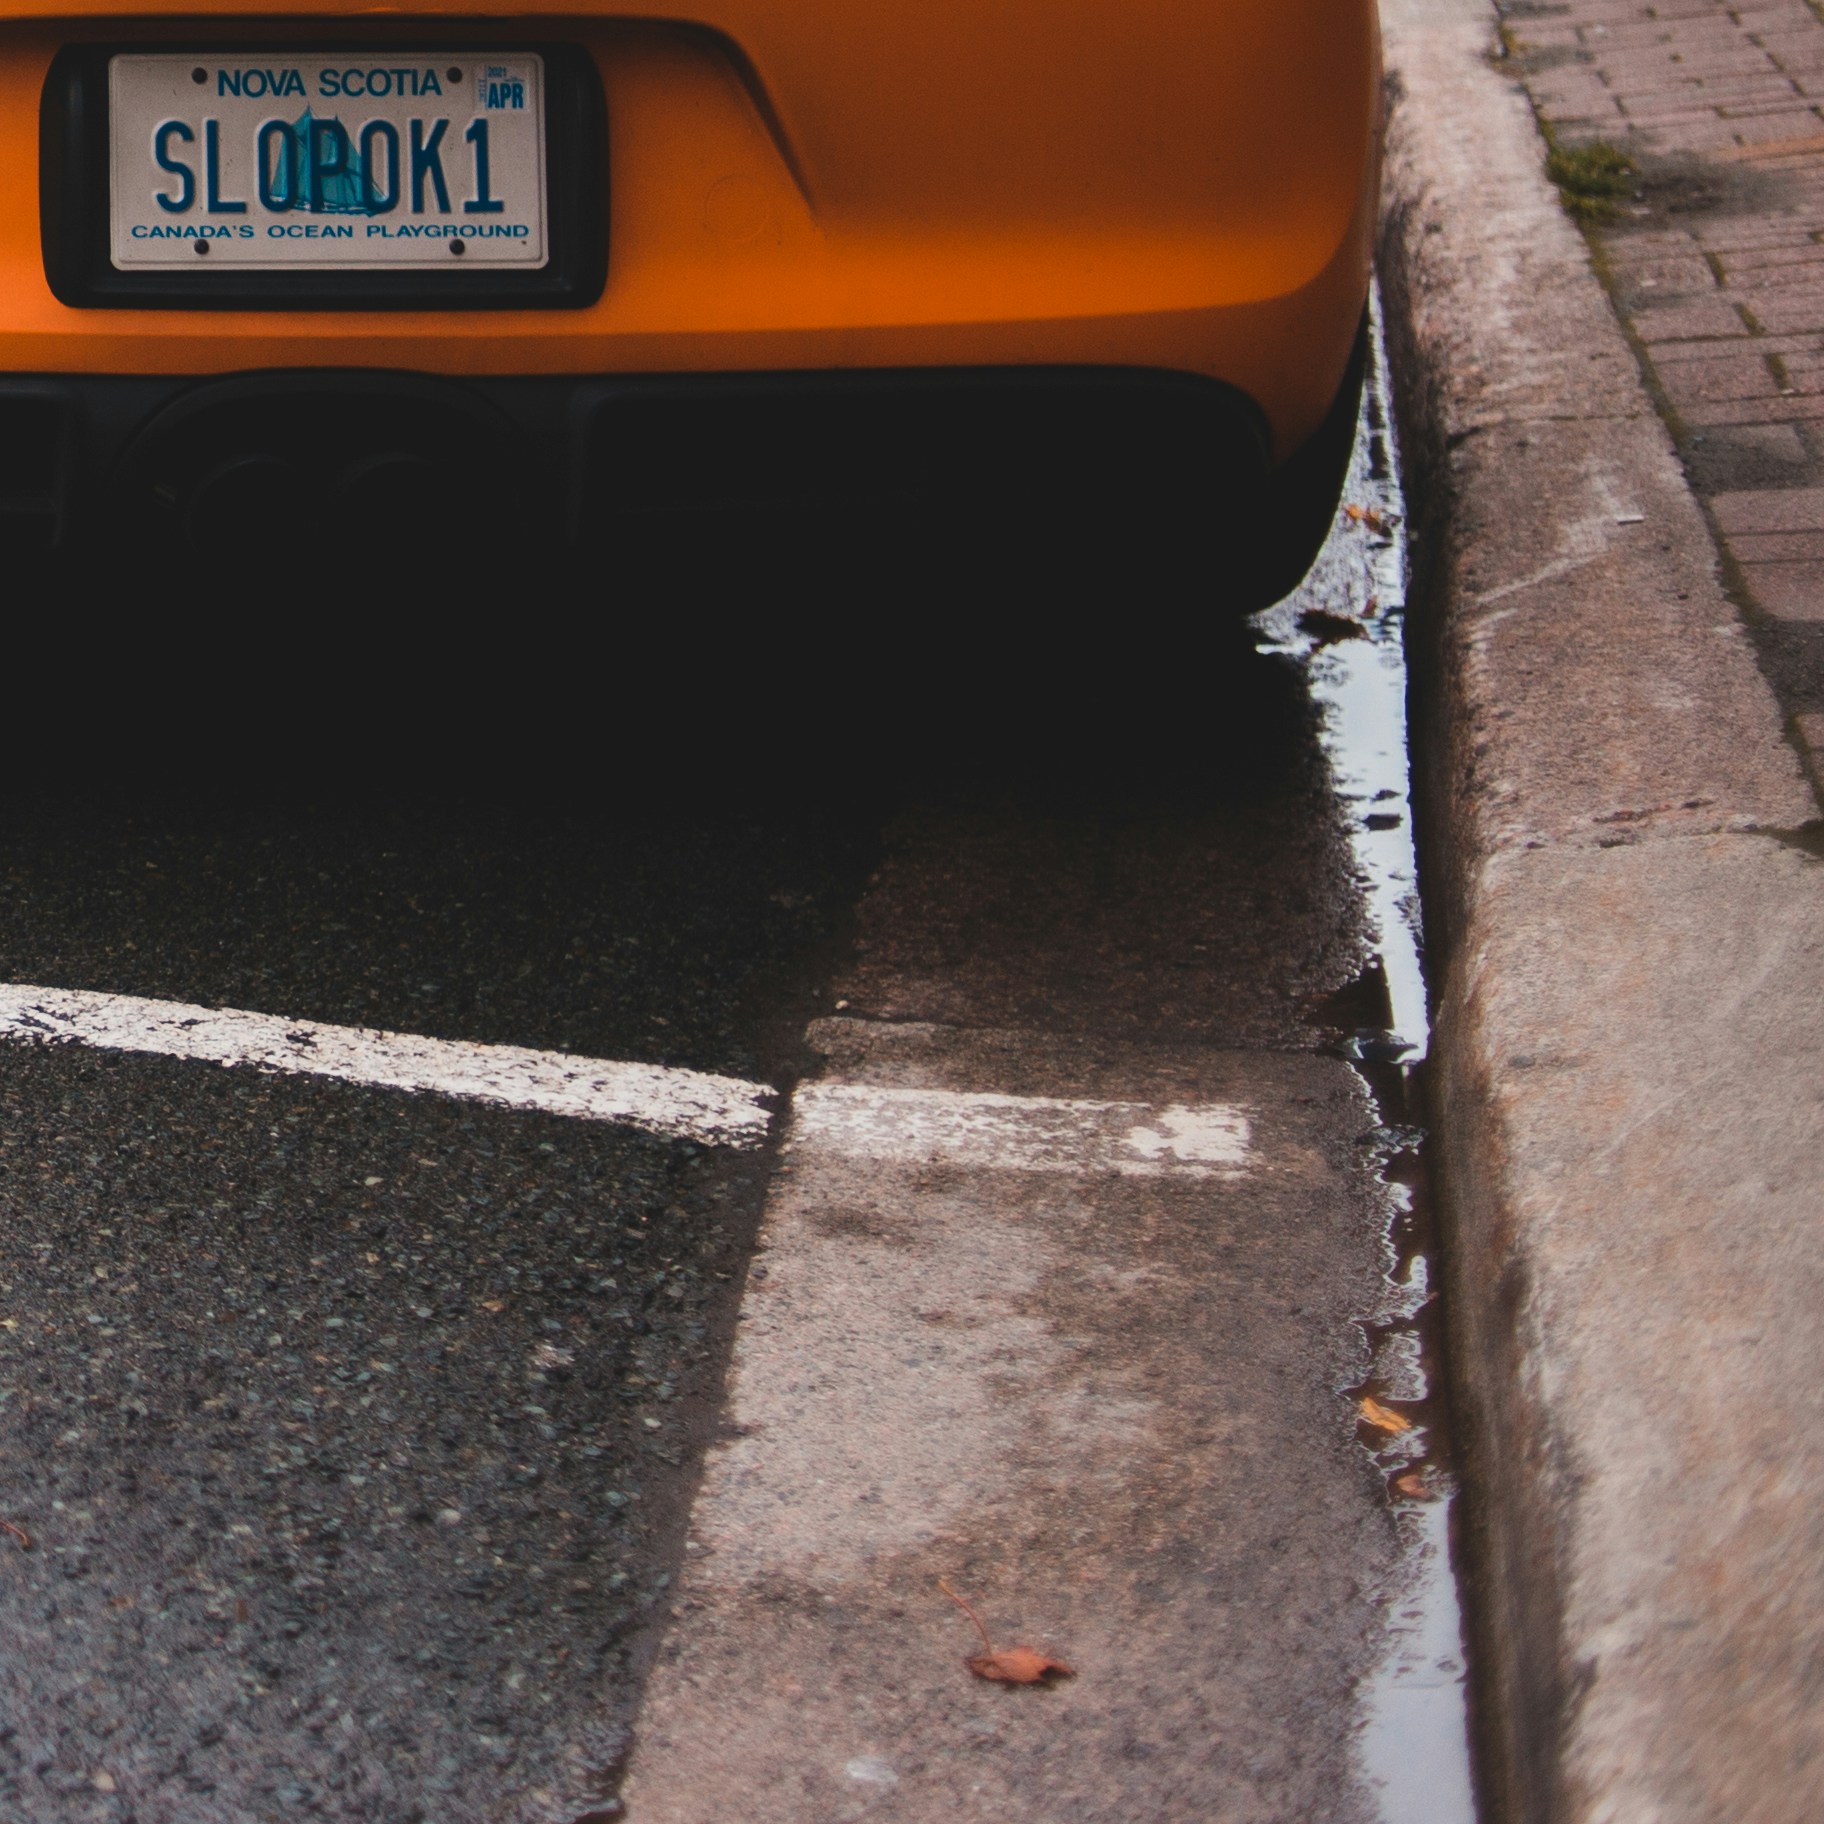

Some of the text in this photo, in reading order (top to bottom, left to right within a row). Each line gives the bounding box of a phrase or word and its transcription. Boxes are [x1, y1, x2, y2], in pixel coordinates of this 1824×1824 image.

[217, 68, 442, 97] NOVA SCOTIA
[487, 82, 523, 109] APR
[131, 224, 530, 238] CANADA'S OCEAN PLAYGROUND
